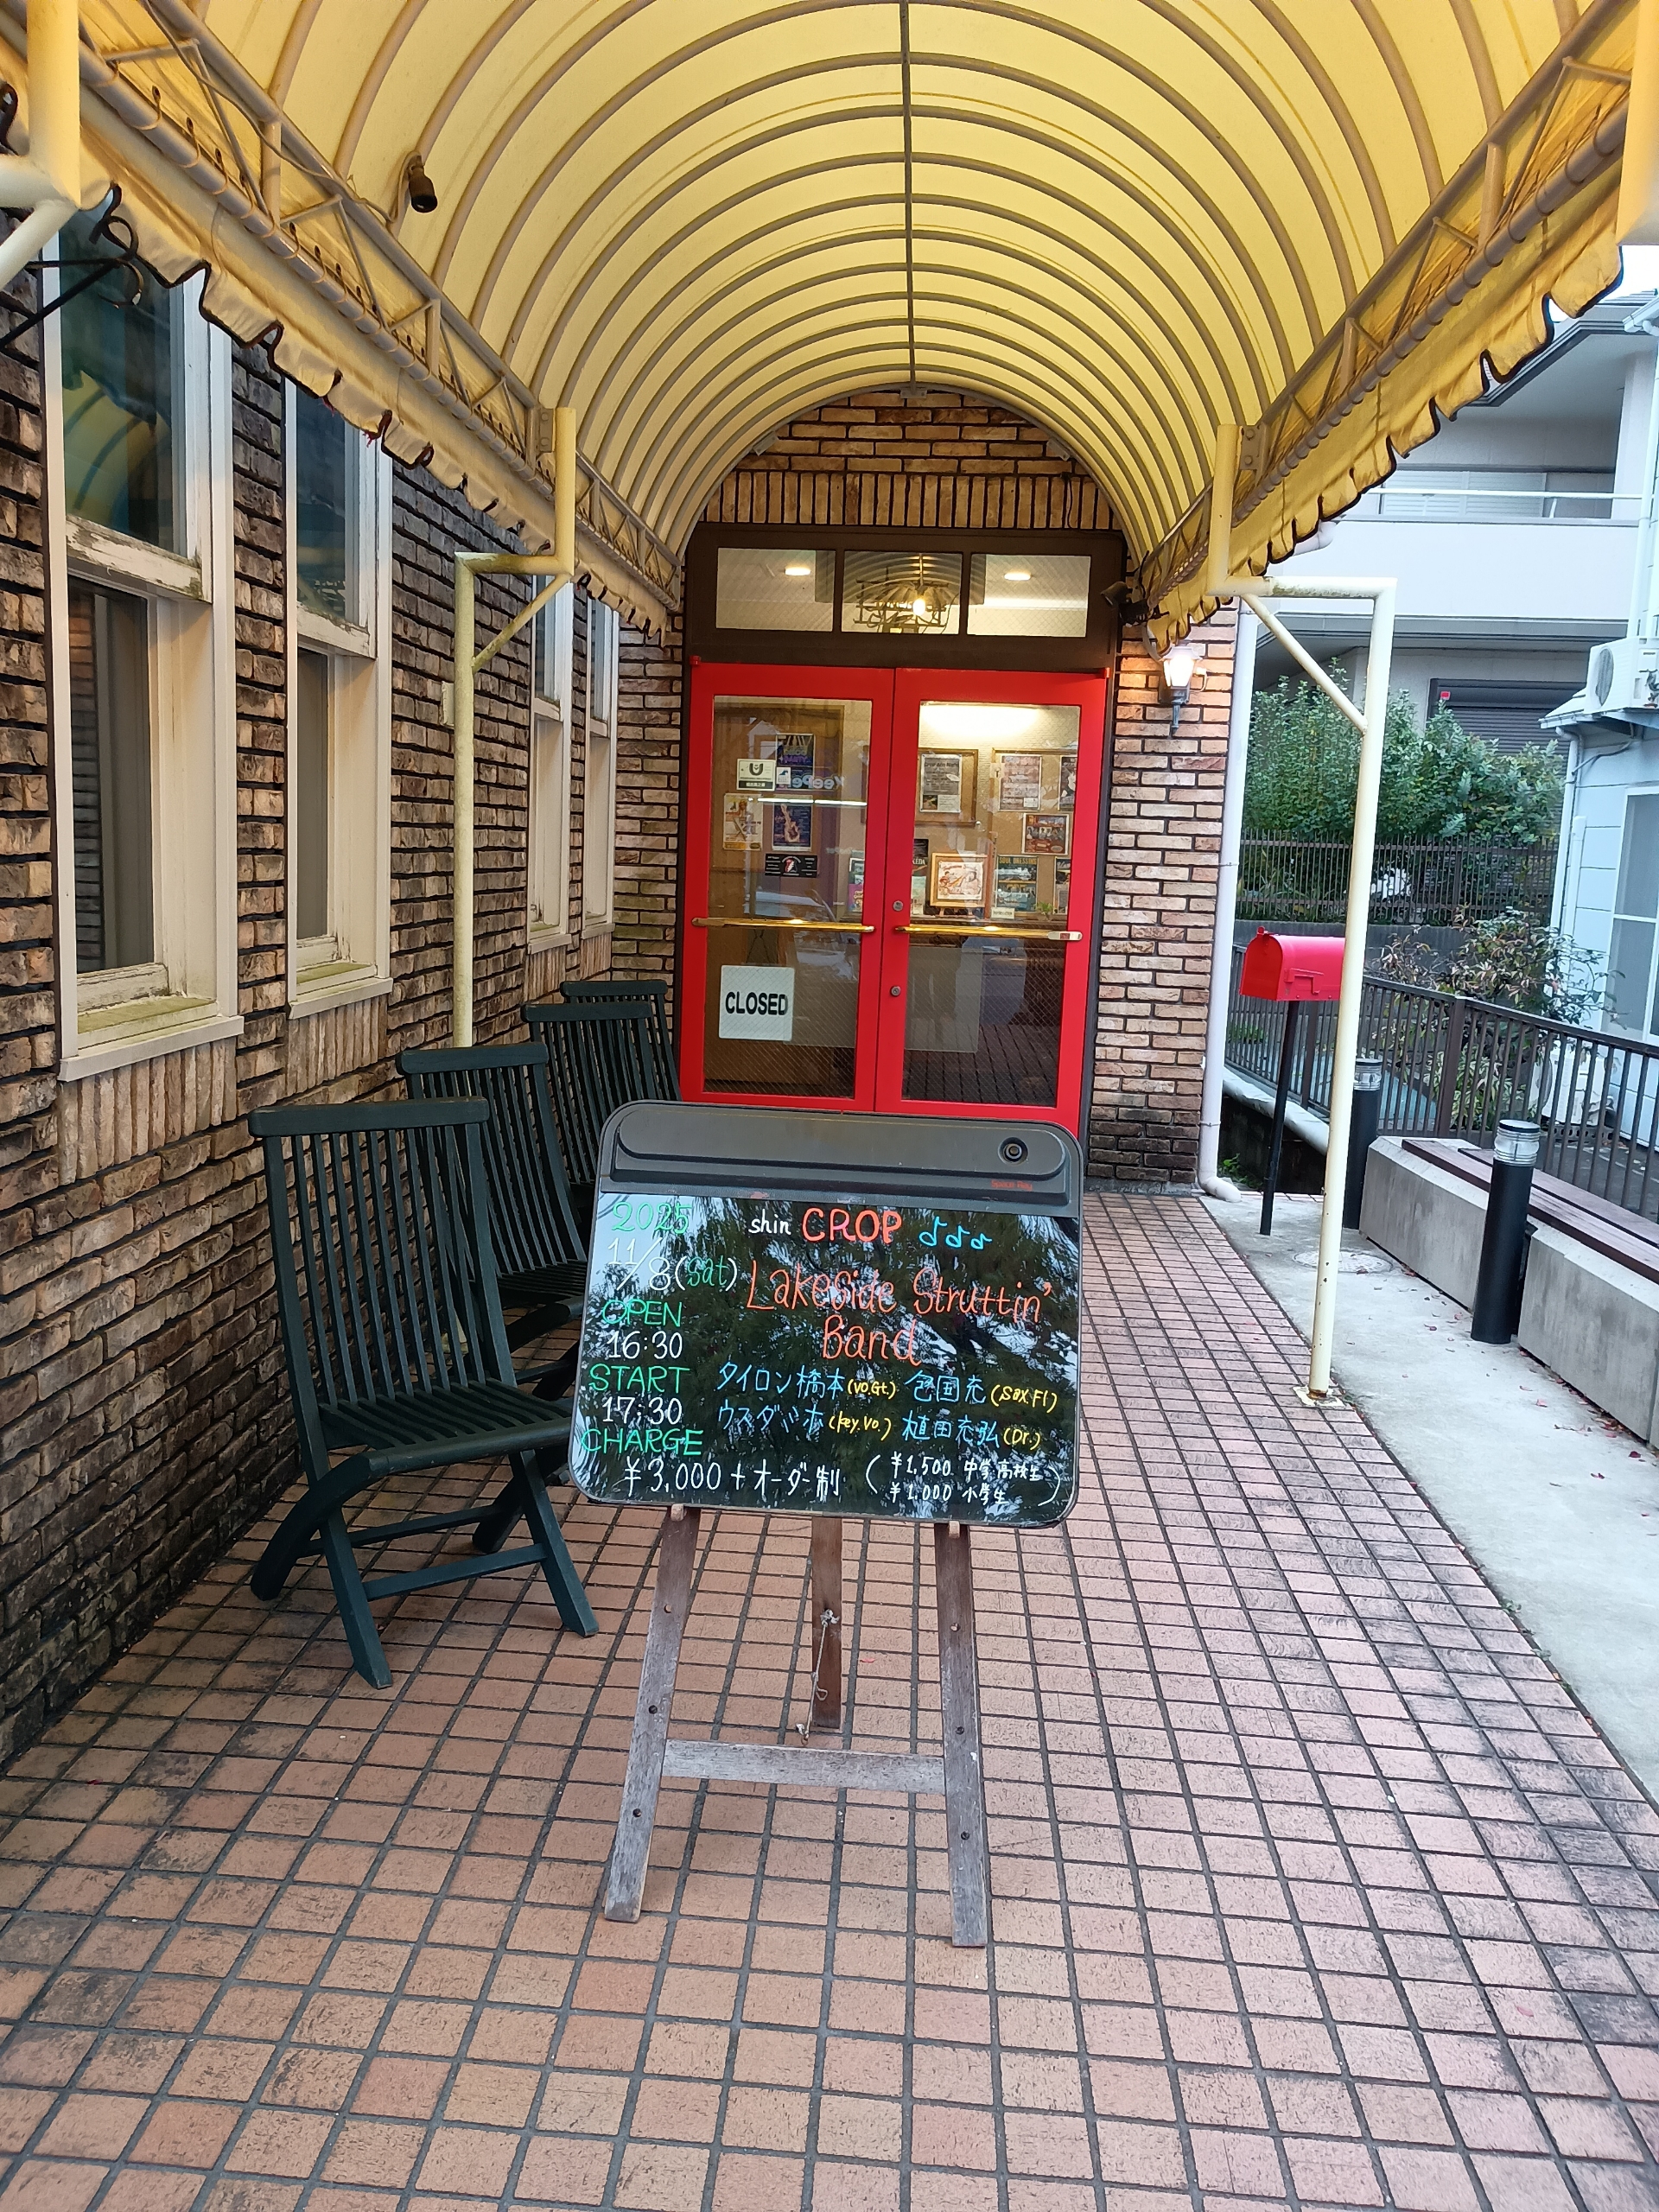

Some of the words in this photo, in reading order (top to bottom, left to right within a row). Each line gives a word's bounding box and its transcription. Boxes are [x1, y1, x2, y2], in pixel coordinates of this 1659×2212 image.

[726, 991, 788, 1015] CLOSED
[611, 1201, 692, 1234] 2025
[748, 1209, 791, 1236] shin
[802, 1208, 902, 1243] CROP
[602, 1299, 683, 1327] OPEN
[606, 1331, 683, 1359] 16:30
[823, 1314, 923, 1366] Band
[588, 1363, 690, 1394] START
[602, 1396, 683, 1425] 17:30
[581, 1427, 704, 1456] CHARGE
